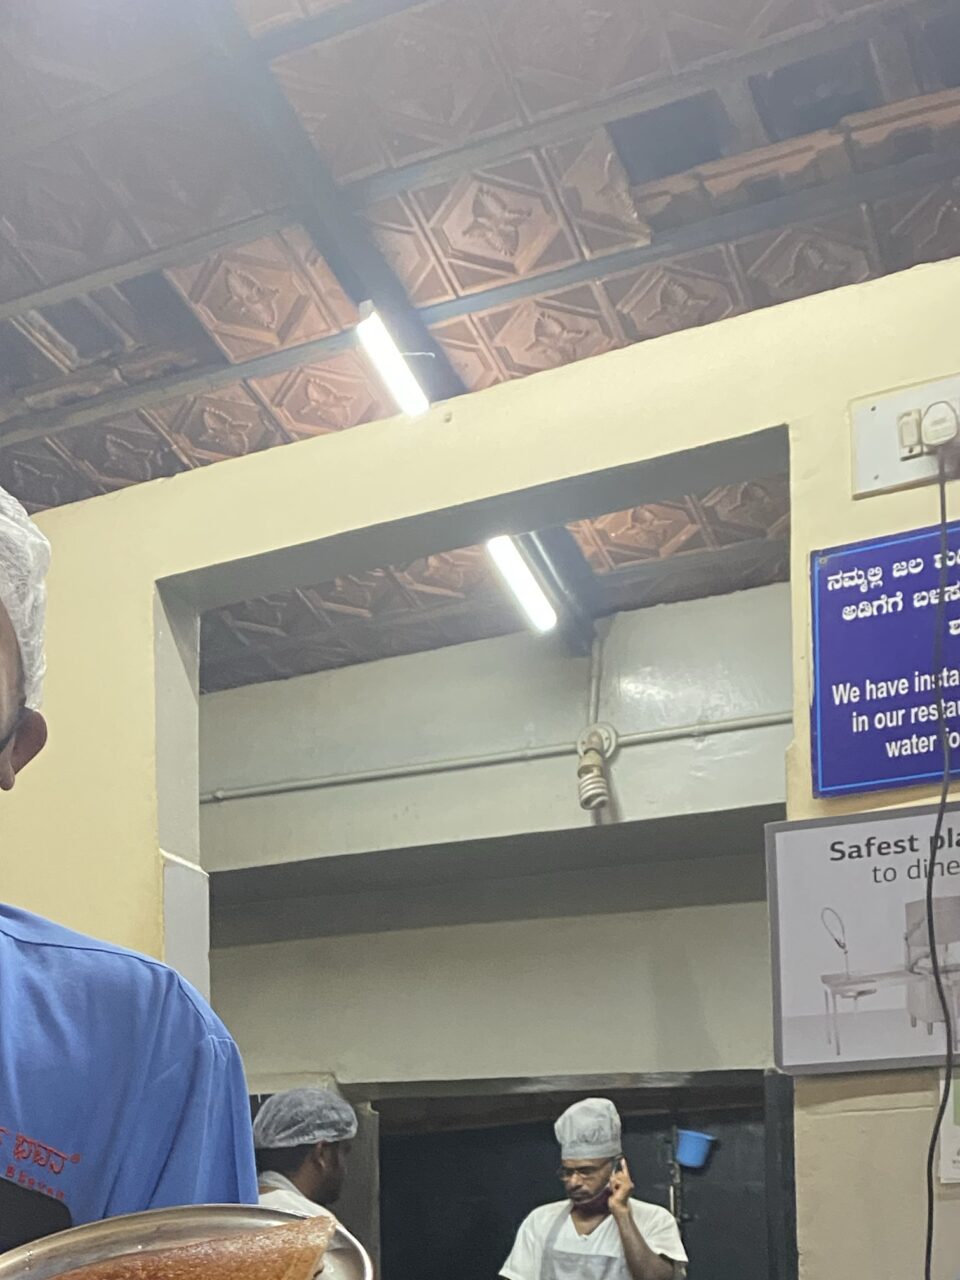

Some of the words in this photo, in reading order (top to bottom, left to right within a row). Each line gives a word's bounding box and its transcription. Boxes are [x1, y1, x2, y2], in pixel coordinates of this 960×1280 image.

[892, 558, 923, 577] ಜಲ
[832, 682, 860, 705] We
[866, 678, 909, 700] have
[852, 711, 868, 732] in
[874, 709, 905, 729] our
[885, 734, 937, 757] water
[829, 834, 920, 862] Safest
[872, 866, 897, 884] to
